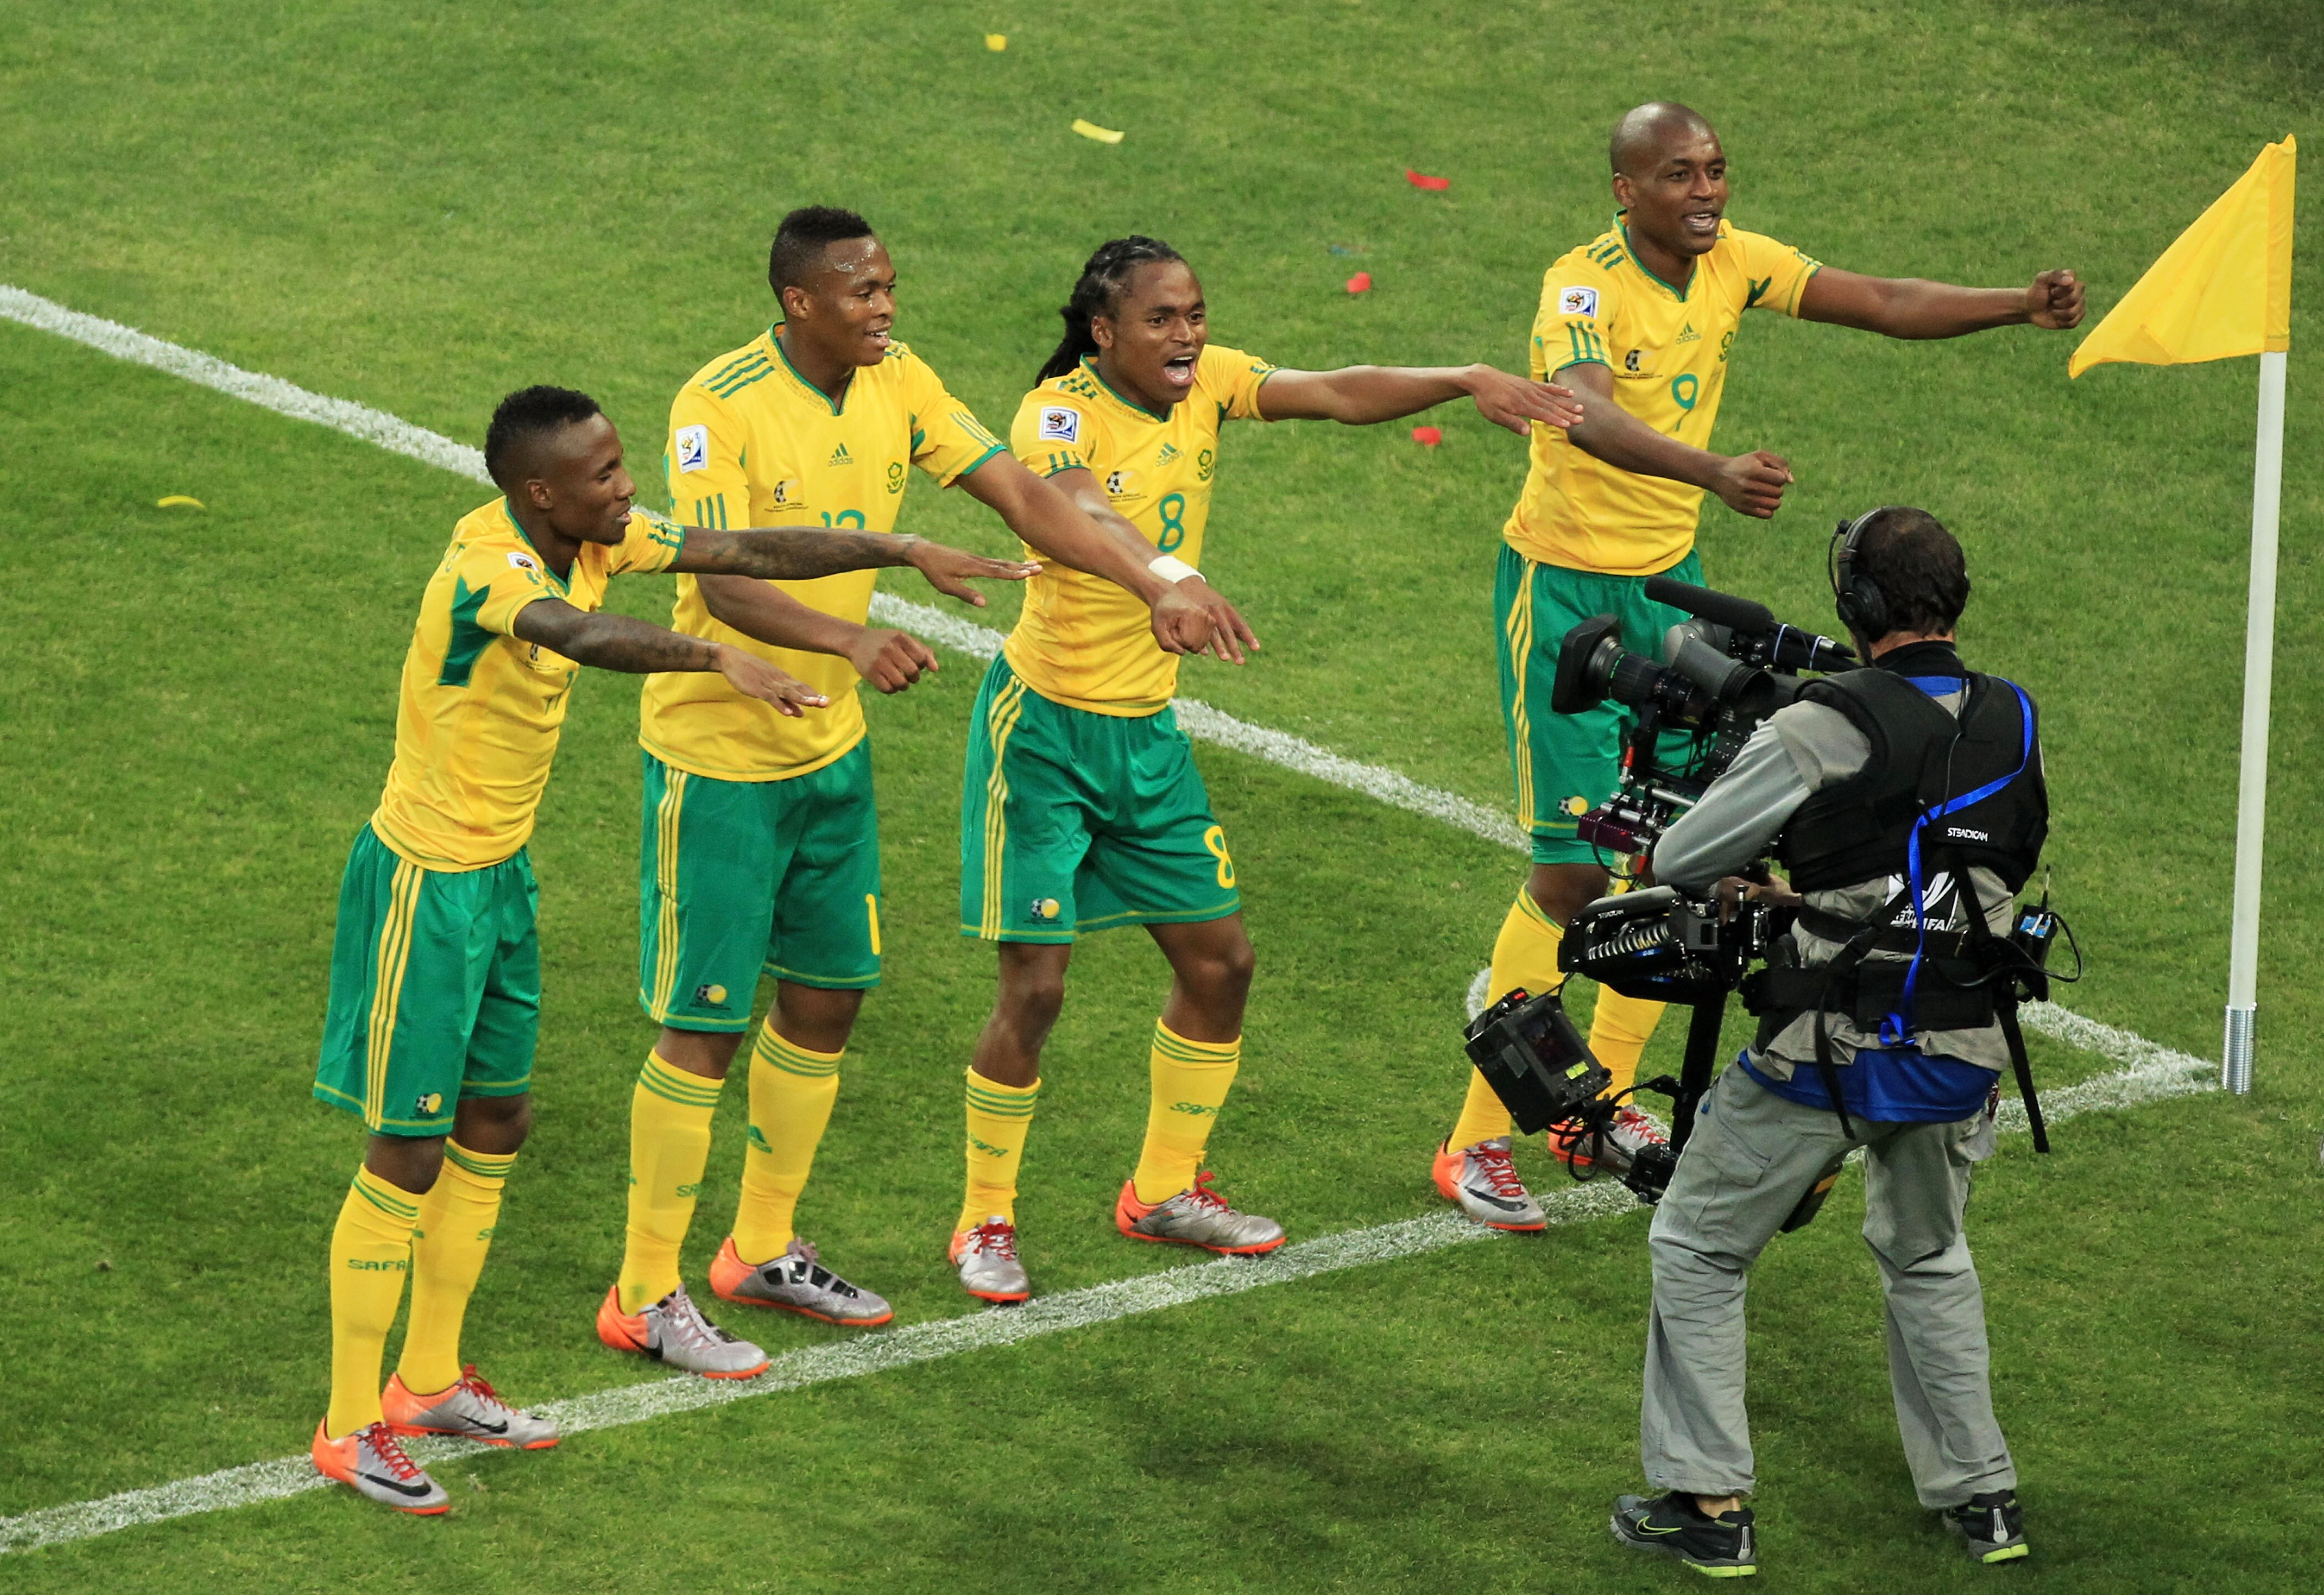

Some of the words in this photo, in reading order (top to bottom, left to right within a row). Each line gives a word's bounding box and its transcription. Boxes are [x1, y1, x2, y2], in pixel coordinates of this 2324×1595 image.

[828, 457, 854, 467] adidas
[1157, 493, 1185, 553] 8
[1947, 827, 1988, 842] STEADICAM
[1204, 825, 1236, 889] 8
